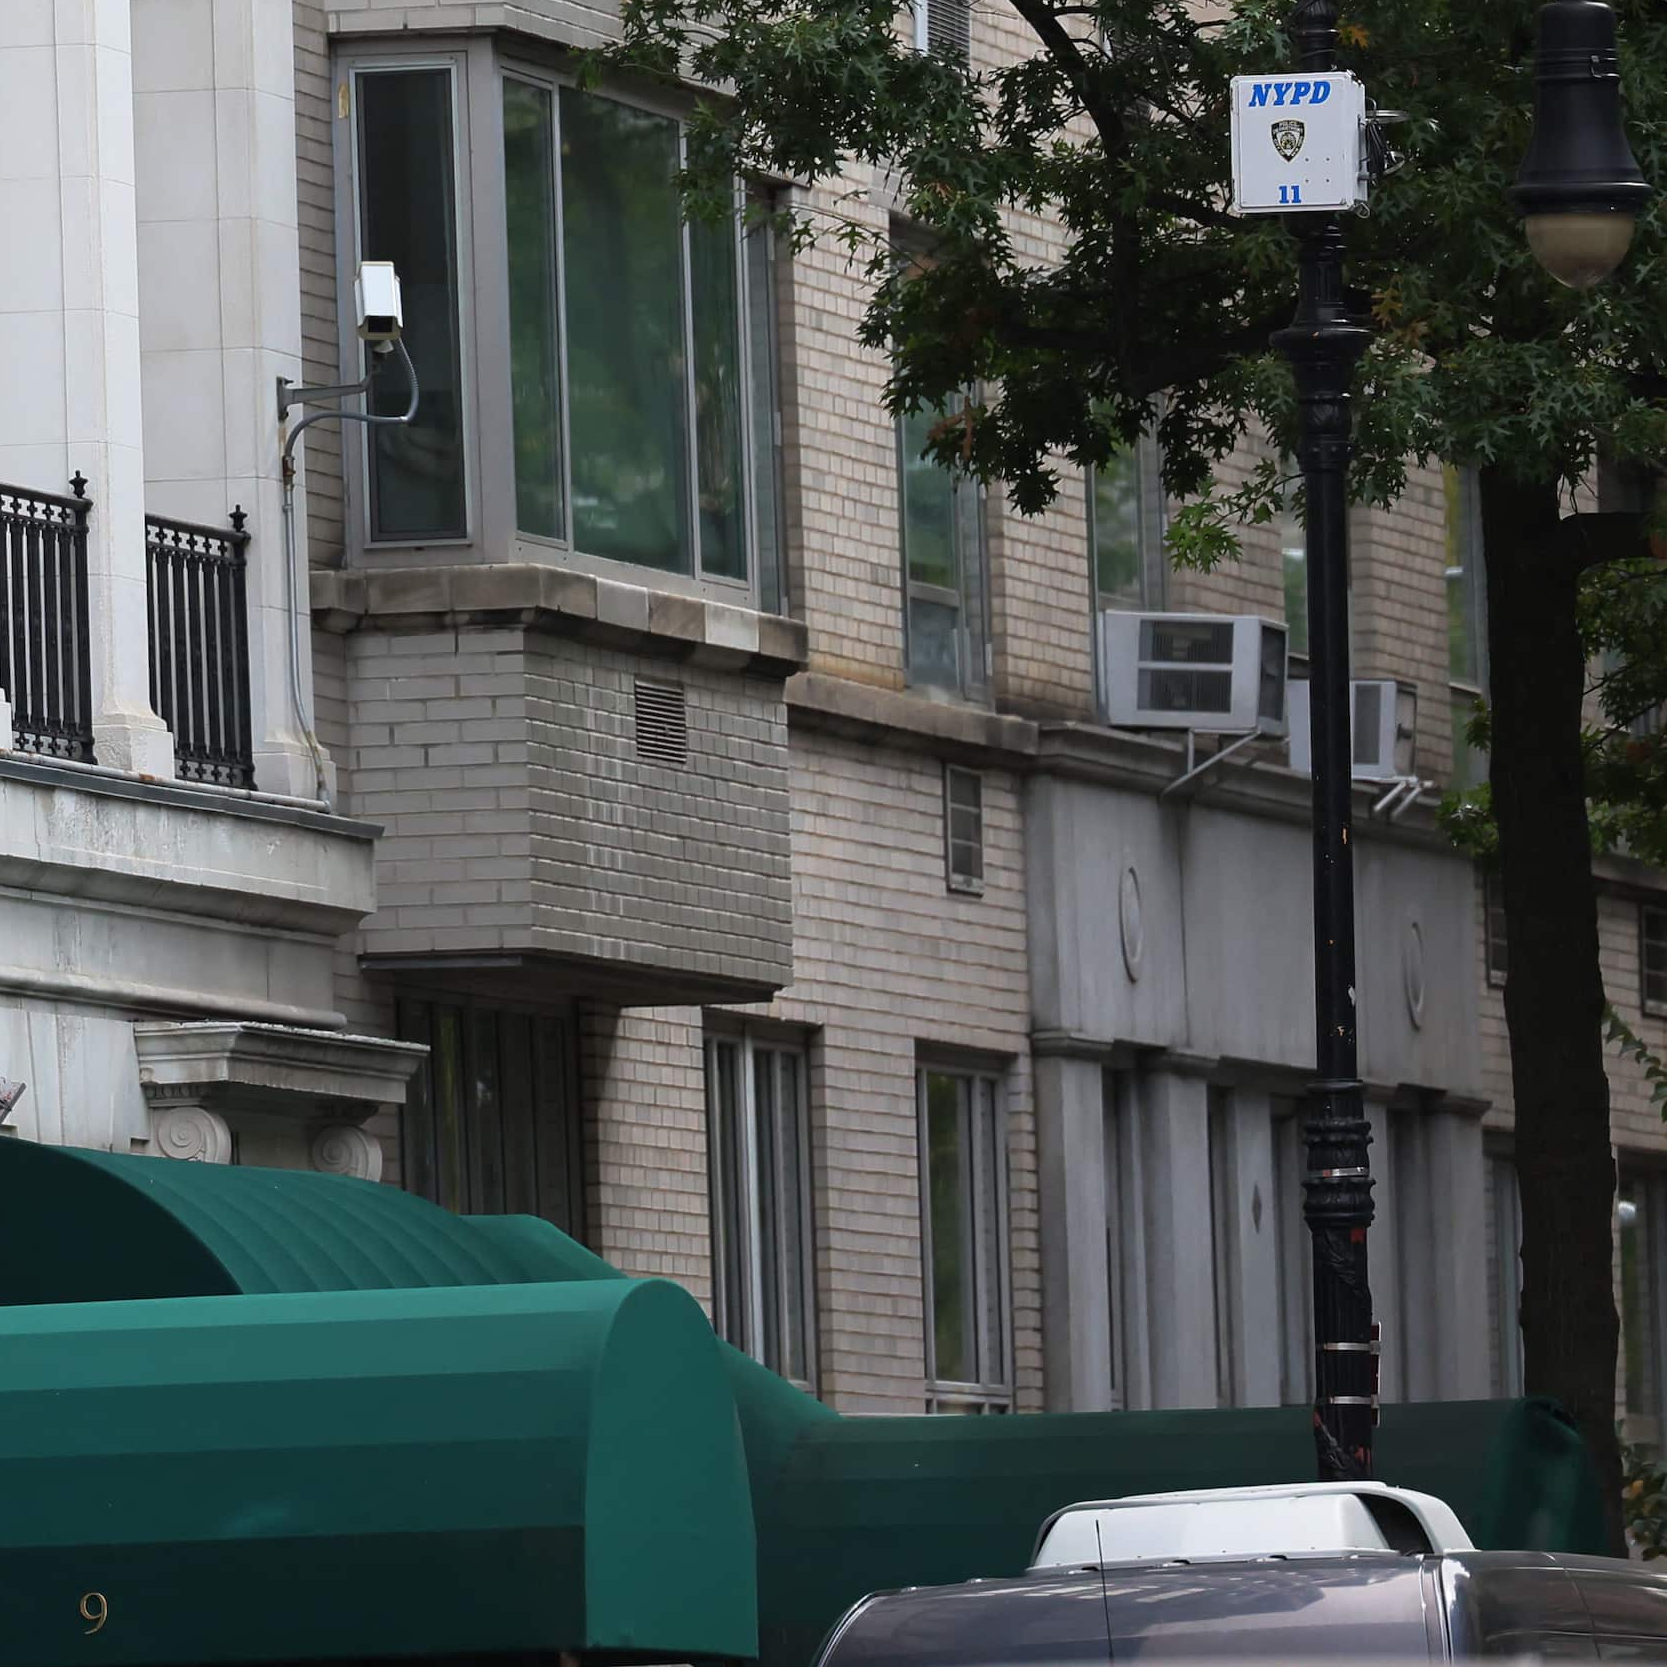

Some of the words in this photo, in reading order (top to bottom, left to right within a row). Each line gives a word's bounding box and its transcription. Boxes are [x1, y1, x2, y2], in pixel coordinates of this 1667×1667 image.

[1248, 80, 1331, 107] NYPD
[1278, 185, 1302, 204] 11
[80, 1592, 108, 1635] 9
